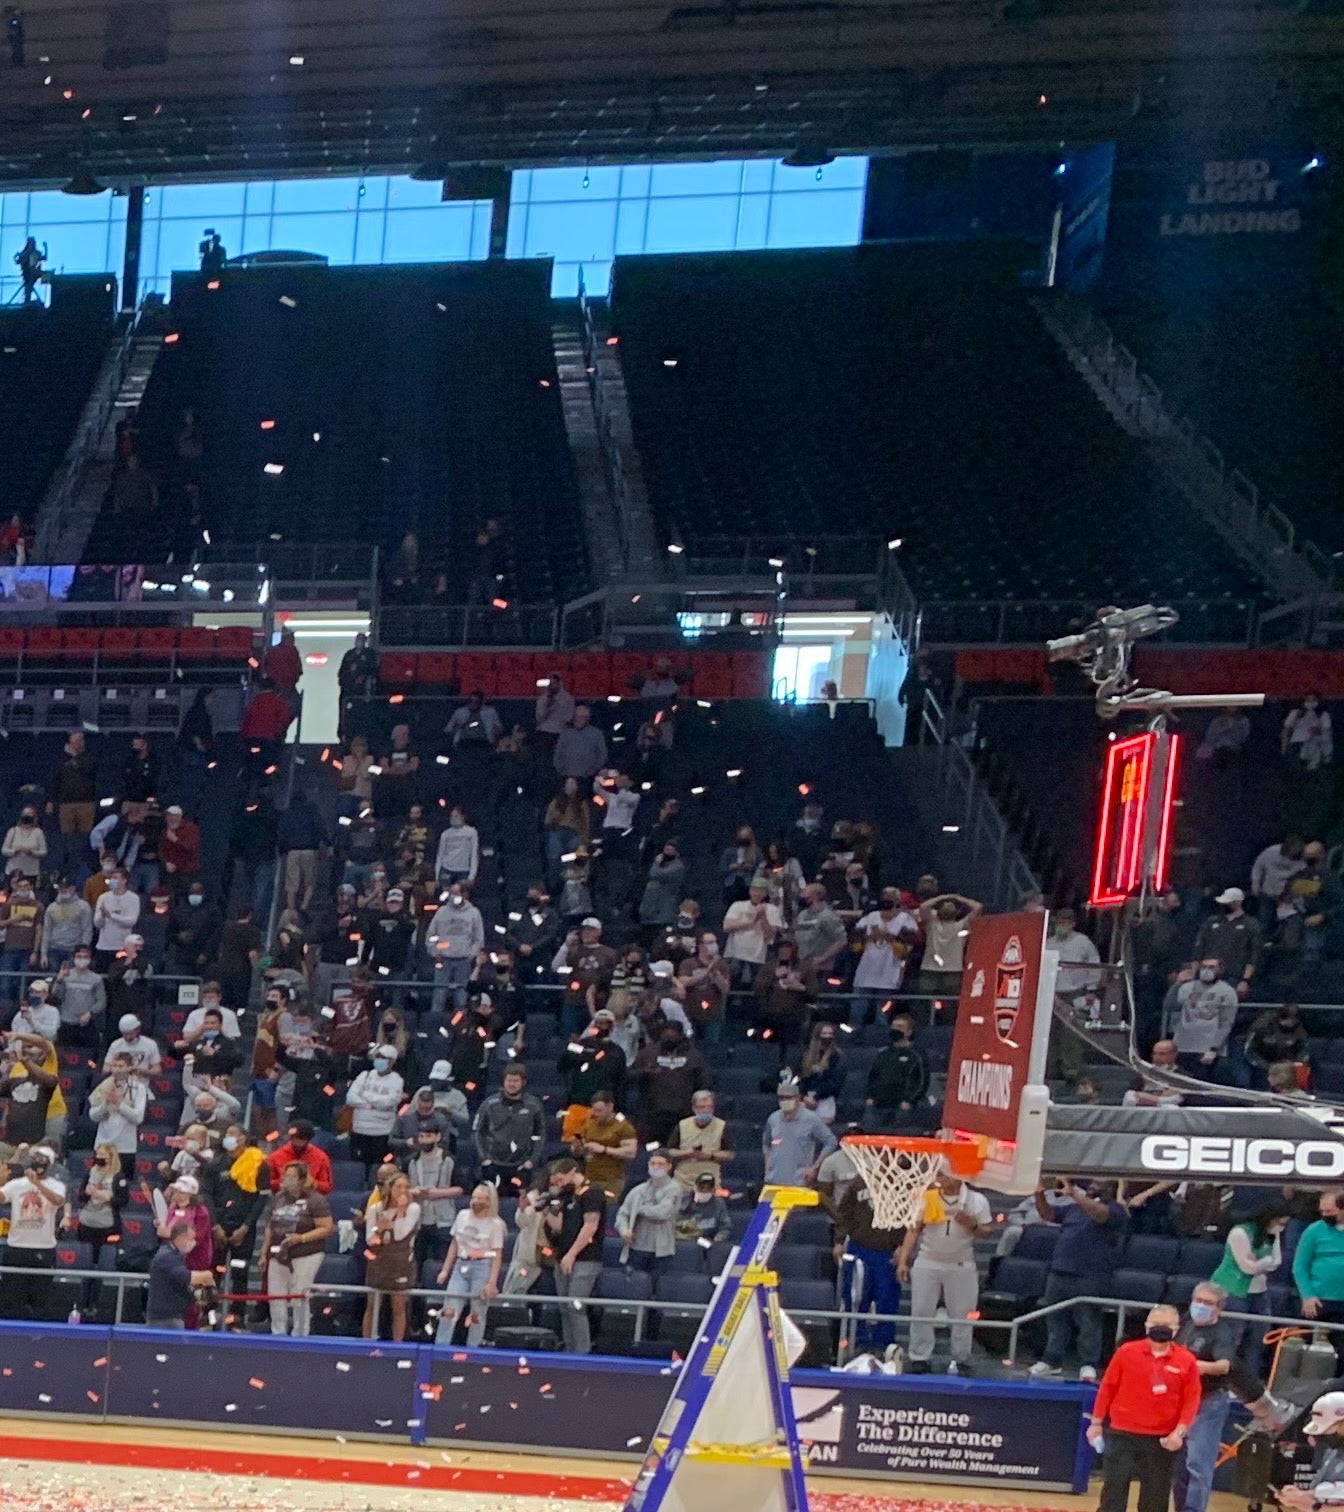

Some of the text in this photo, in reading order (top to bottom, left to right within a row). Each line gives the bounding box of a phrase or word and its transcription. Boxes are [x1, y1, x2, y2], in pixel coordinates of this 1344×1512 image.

[1160, 208, 1302, 236] LANDING
[957, 1059, 1013, 1111] CHAMPIONS
[1141, 1135, 1344, 1177] GEICO
[858, 1404, 971, 1428] Experience
[857, 1422, 1004, 1449] The Difference
[857, 1442, 994, 1461] Celebrating Over 50 Years
[887, 1454, 1040, 1476] of Pure Wealth Management
